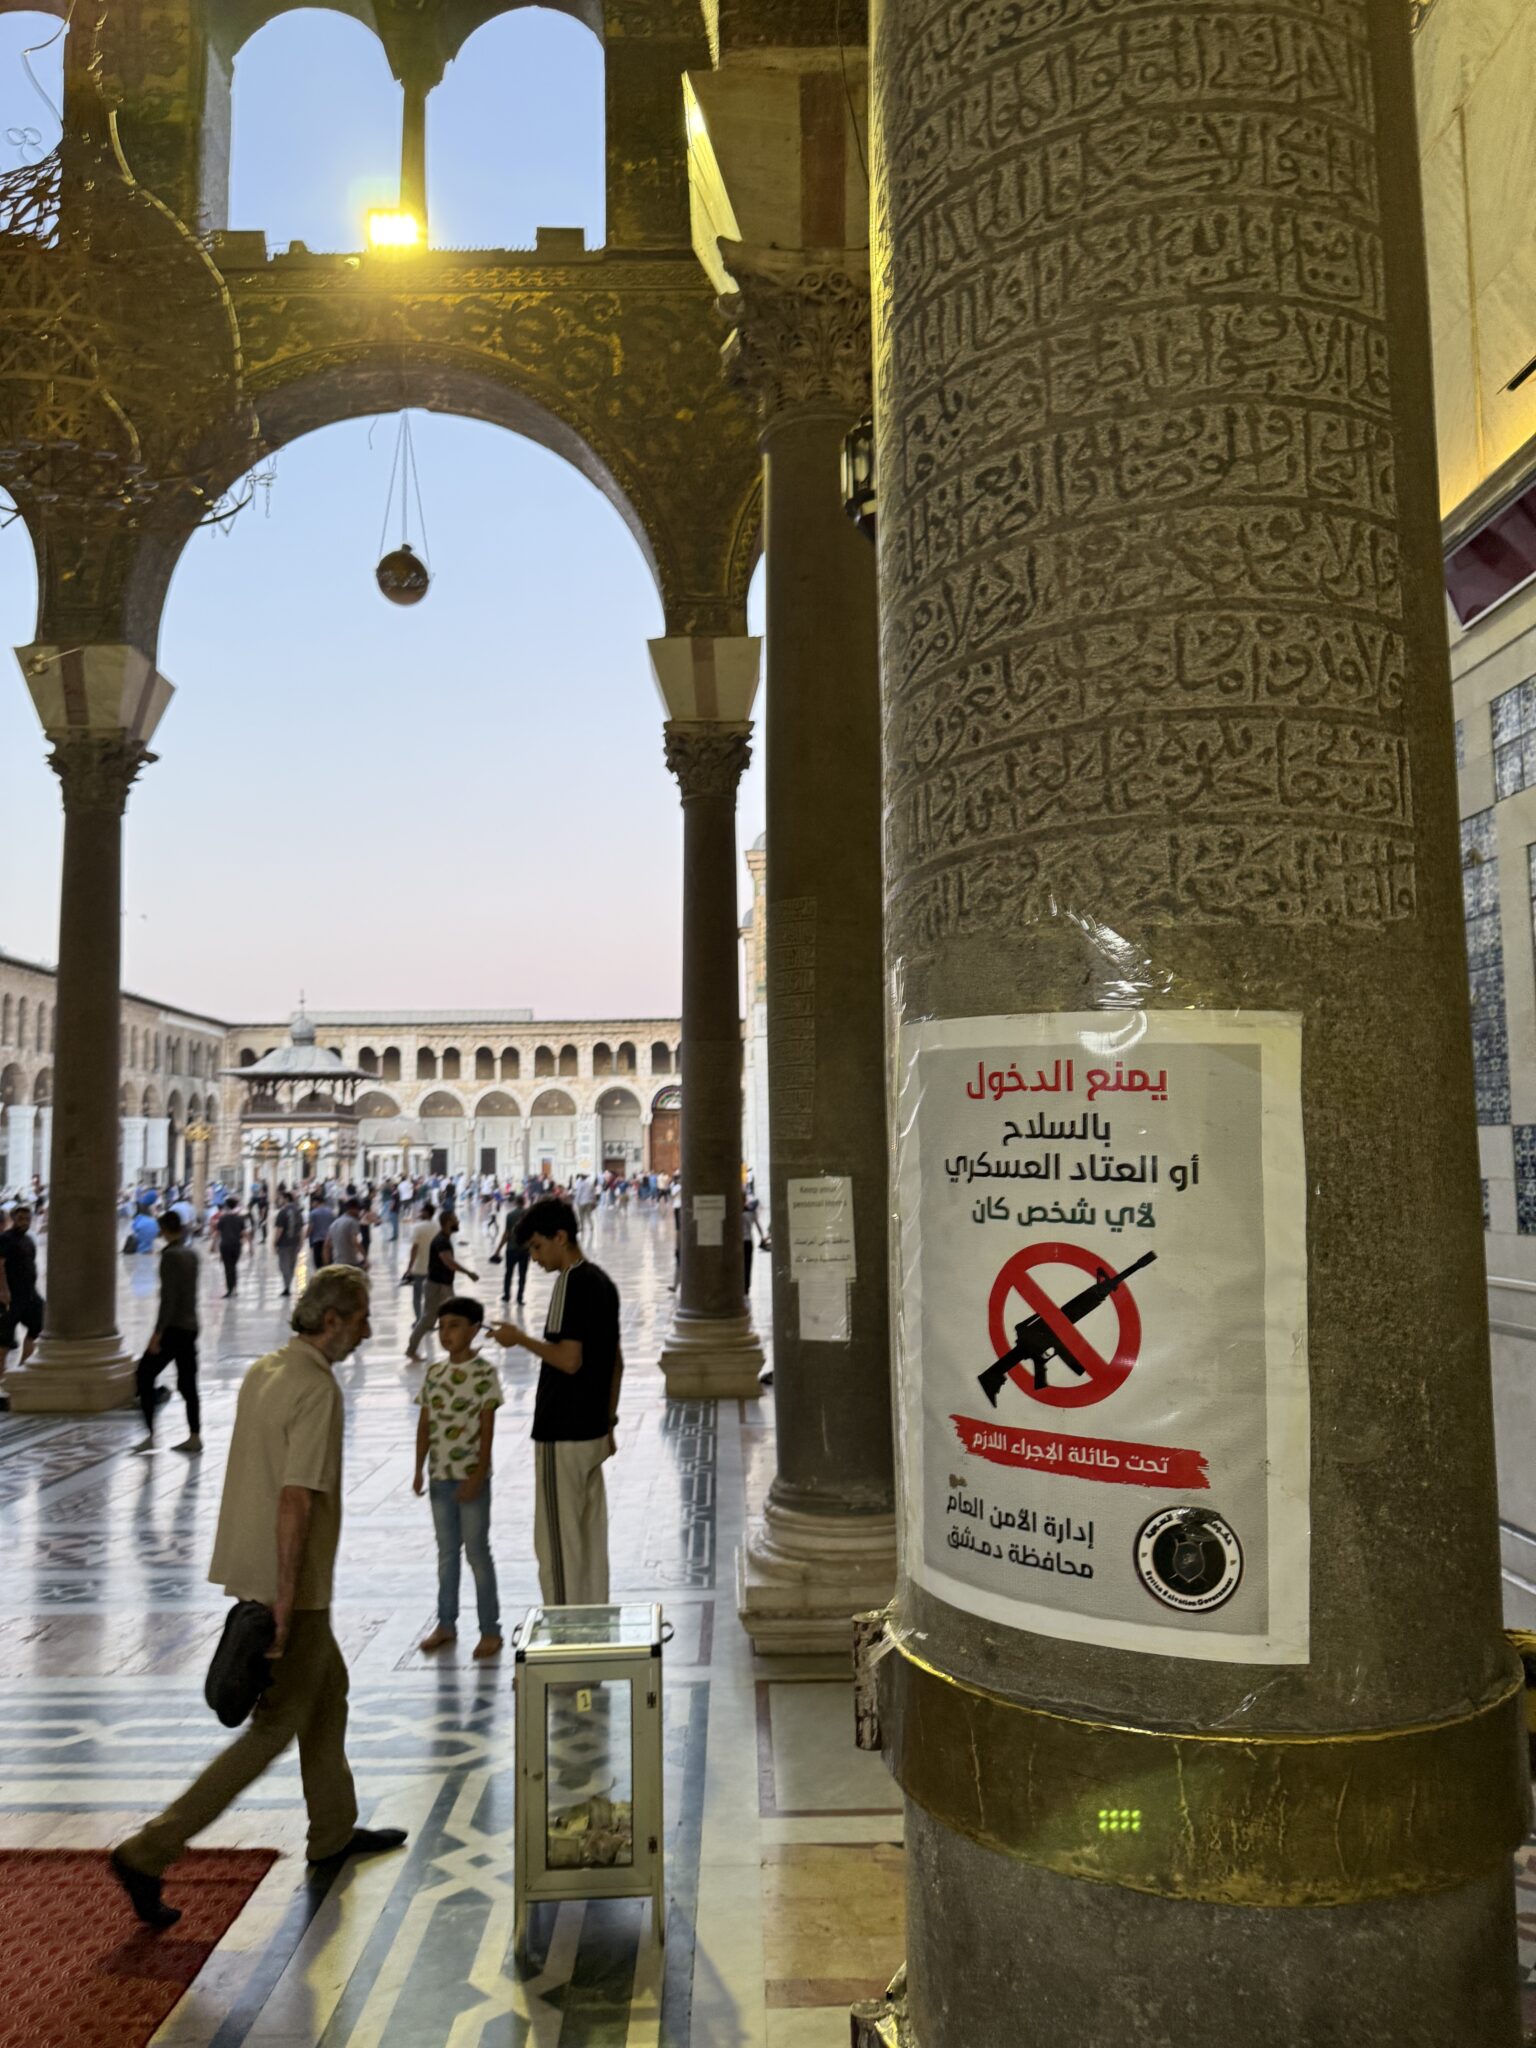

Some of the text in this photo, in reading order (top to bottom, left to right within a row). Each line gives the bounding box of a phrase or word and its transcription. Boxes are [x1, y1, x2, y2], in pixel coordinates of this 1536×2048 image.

[966, 1059, 1168, 1101] يمنع الدخول
[1002, 1112, 1111, 1147] بالسلاح
[944, 1152, 1199, 1192] أو العتاد العسكري
[971, 1196, 1156, 1233] لأي شخص كان
[971, 1430, 1170, 1474] تحت طائلة الإجراء اللازم
[945, 1491, 1094, 1549] إدارة الأمن العام
[946, 1525, 1094, 1579] محافظة دمشق
